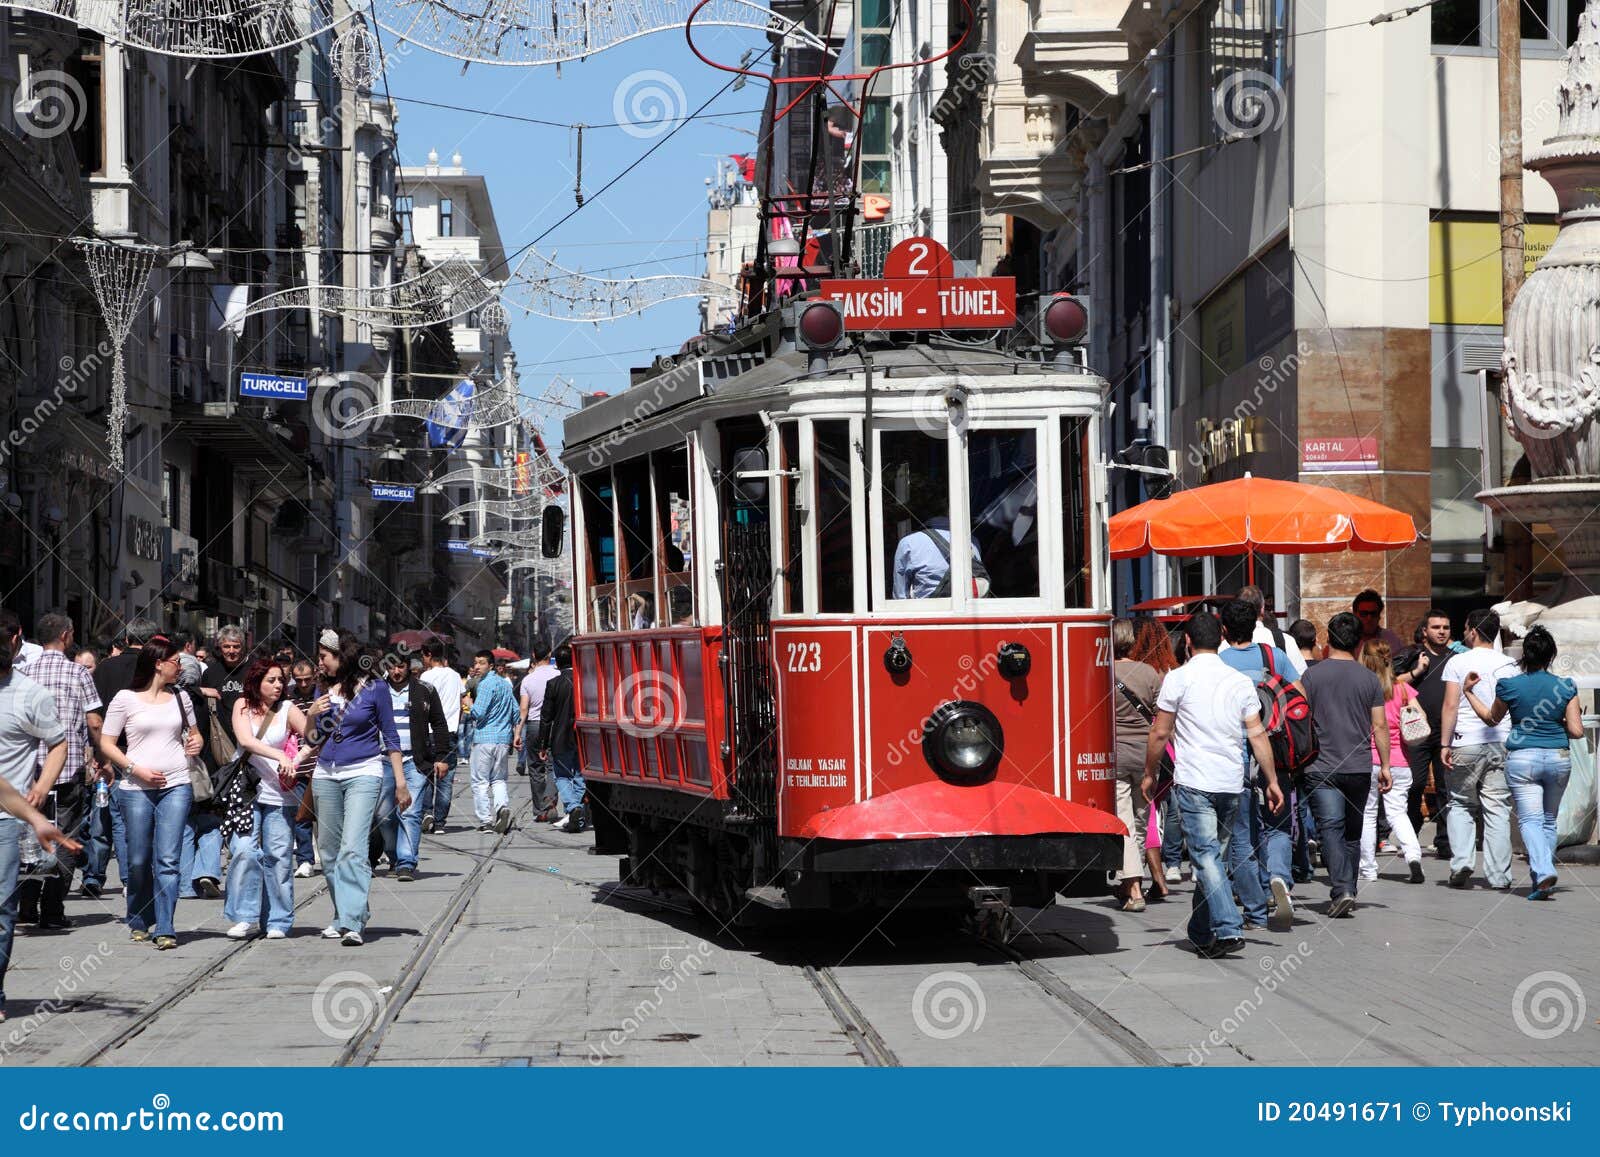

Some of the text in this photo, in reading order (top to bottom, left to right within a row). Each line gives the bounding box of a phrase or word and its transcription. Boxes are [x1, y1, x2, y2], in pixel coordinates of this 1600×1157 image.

[908, 243, 929, 275] 2
[938, 286, 1005, 316] TÜNEL
[243, 378, 305, 394] TURKCELL
[1305, 442, 1345, 452] KARTAL
[374, 488, 413, 499] TURKCELL
[787, 642, 822, 672] 223
[818, 758, 847, 770] YASAK
[787, 775, 795, 787] VE
[1077, 769, 1088, 781] VE
